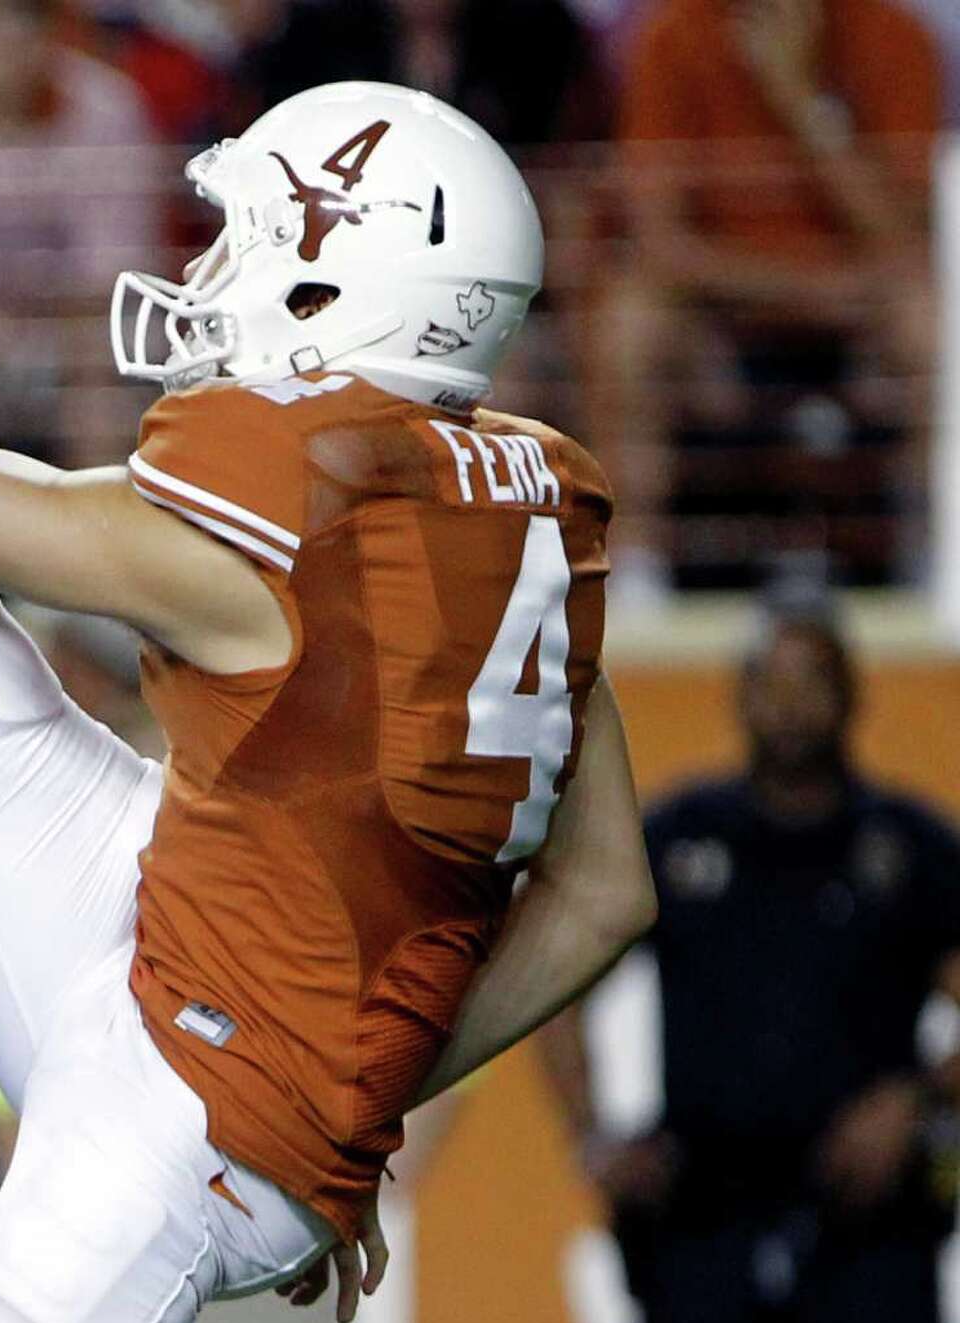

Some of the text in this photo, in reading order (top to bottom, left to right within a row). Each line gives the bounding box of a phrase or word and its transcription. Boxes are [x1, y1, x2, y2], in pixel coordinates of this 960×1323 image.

[321, 119, 391, 192] 4
[428, 419, 560, 507] FERA
[465, 515, 572, 863] 4
